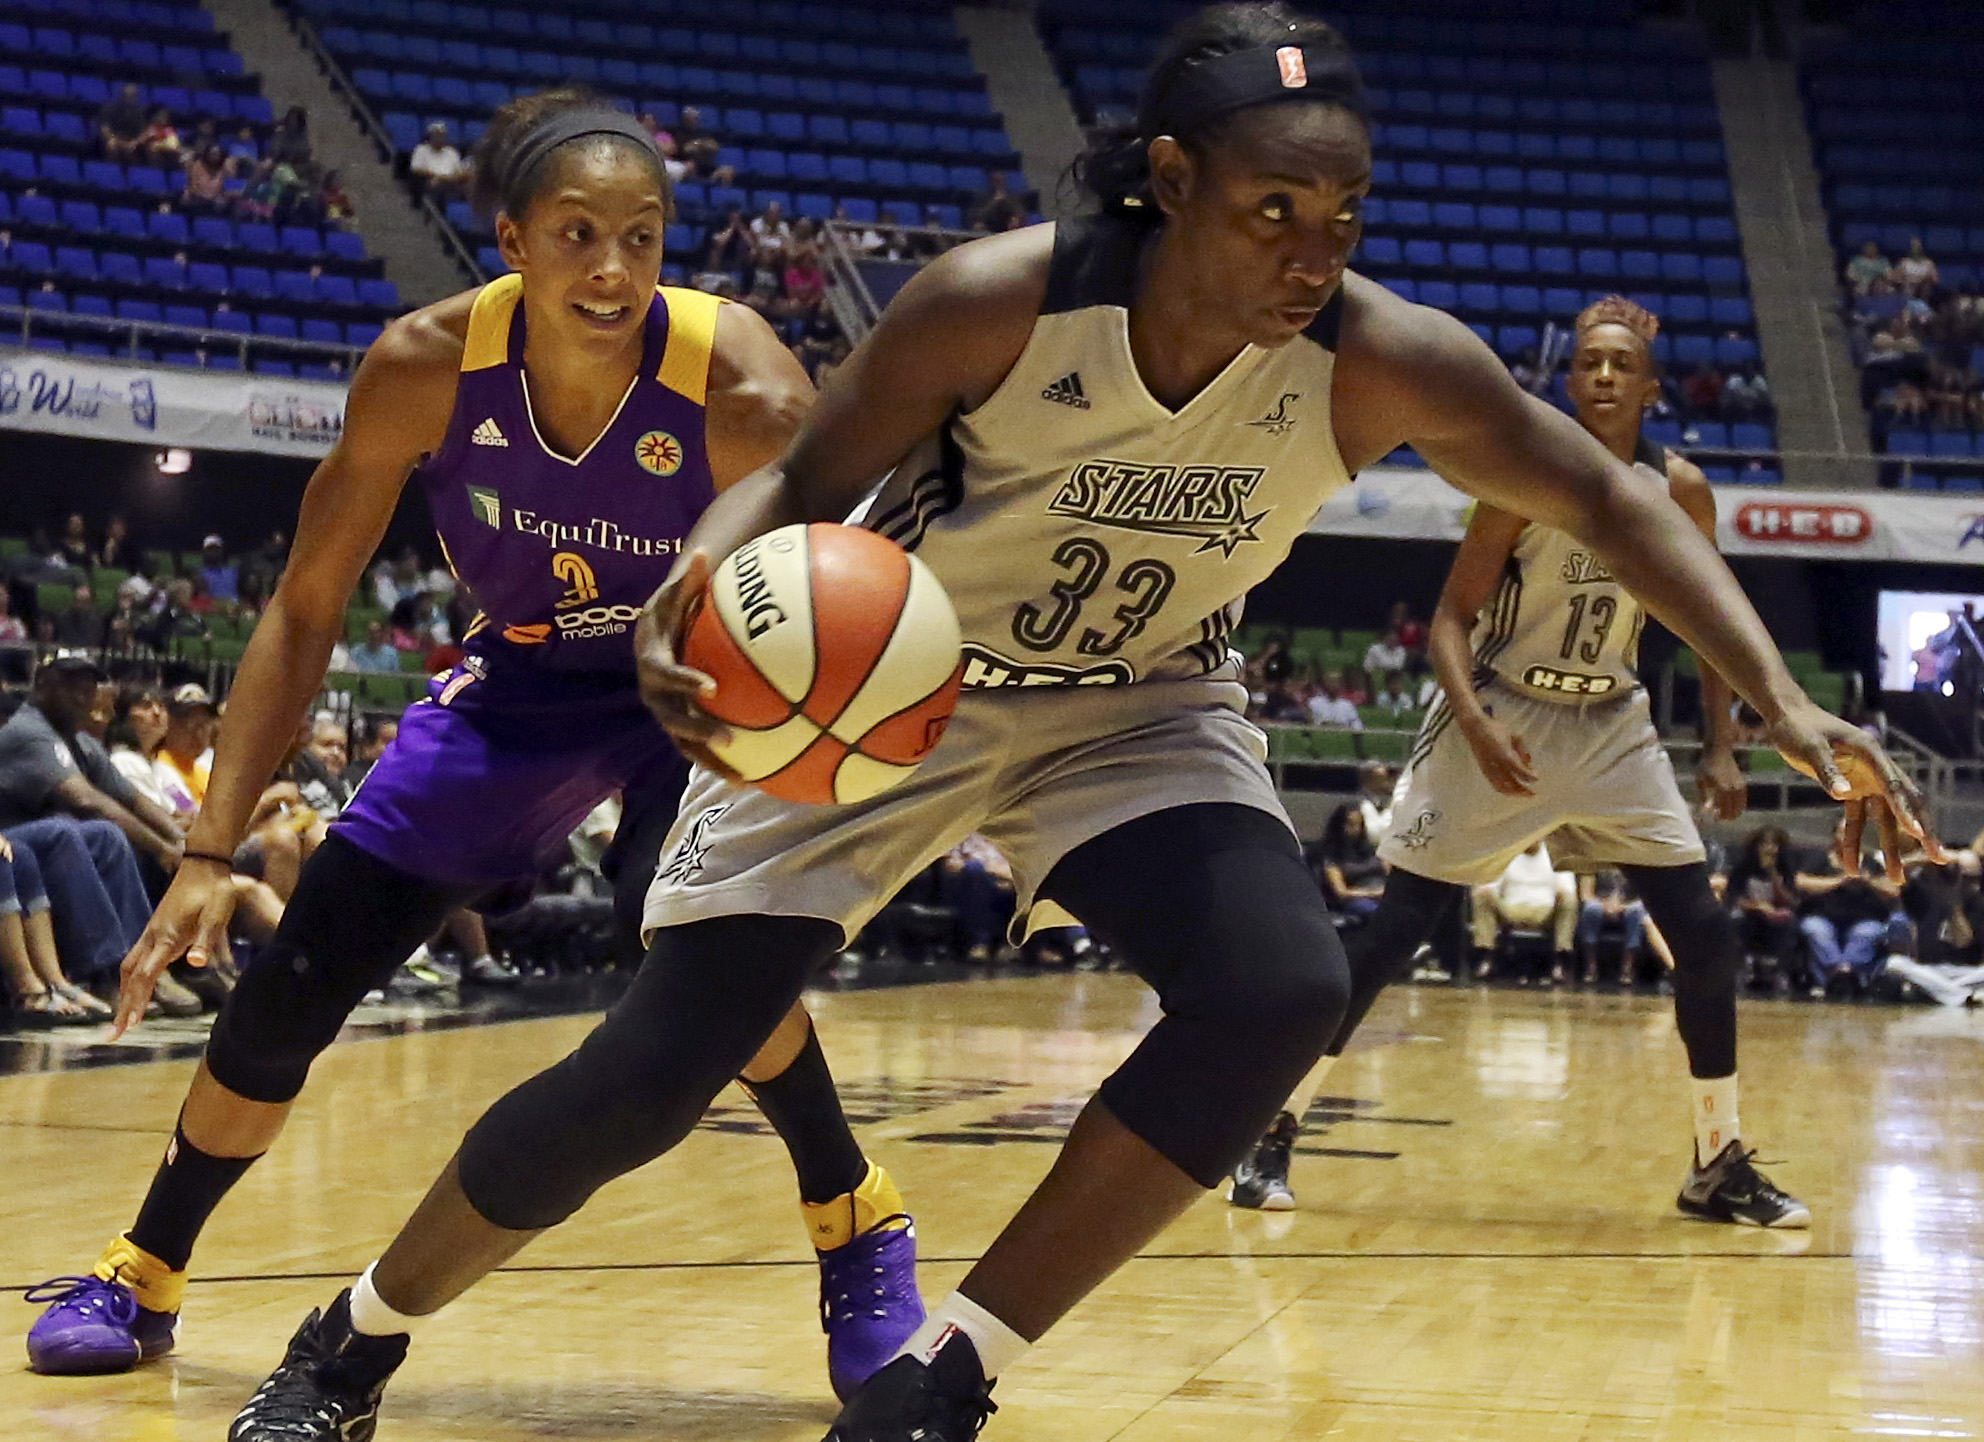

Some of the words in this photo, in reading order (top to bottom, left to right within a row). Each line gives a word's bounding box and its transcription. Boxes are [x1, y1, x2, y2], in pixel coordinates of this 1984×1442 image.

[1041, 389, 1091, 411] adidas
[471, 434, 510, 448] adidas
[1047, 460, 1267, 525] STARS
[512, 508, 684, 556] EquiTrust
[1011, 537, 1177, 656] 33
[562, 623, 627, 640] mobile
[1559, 594, 1617, 664] 13
